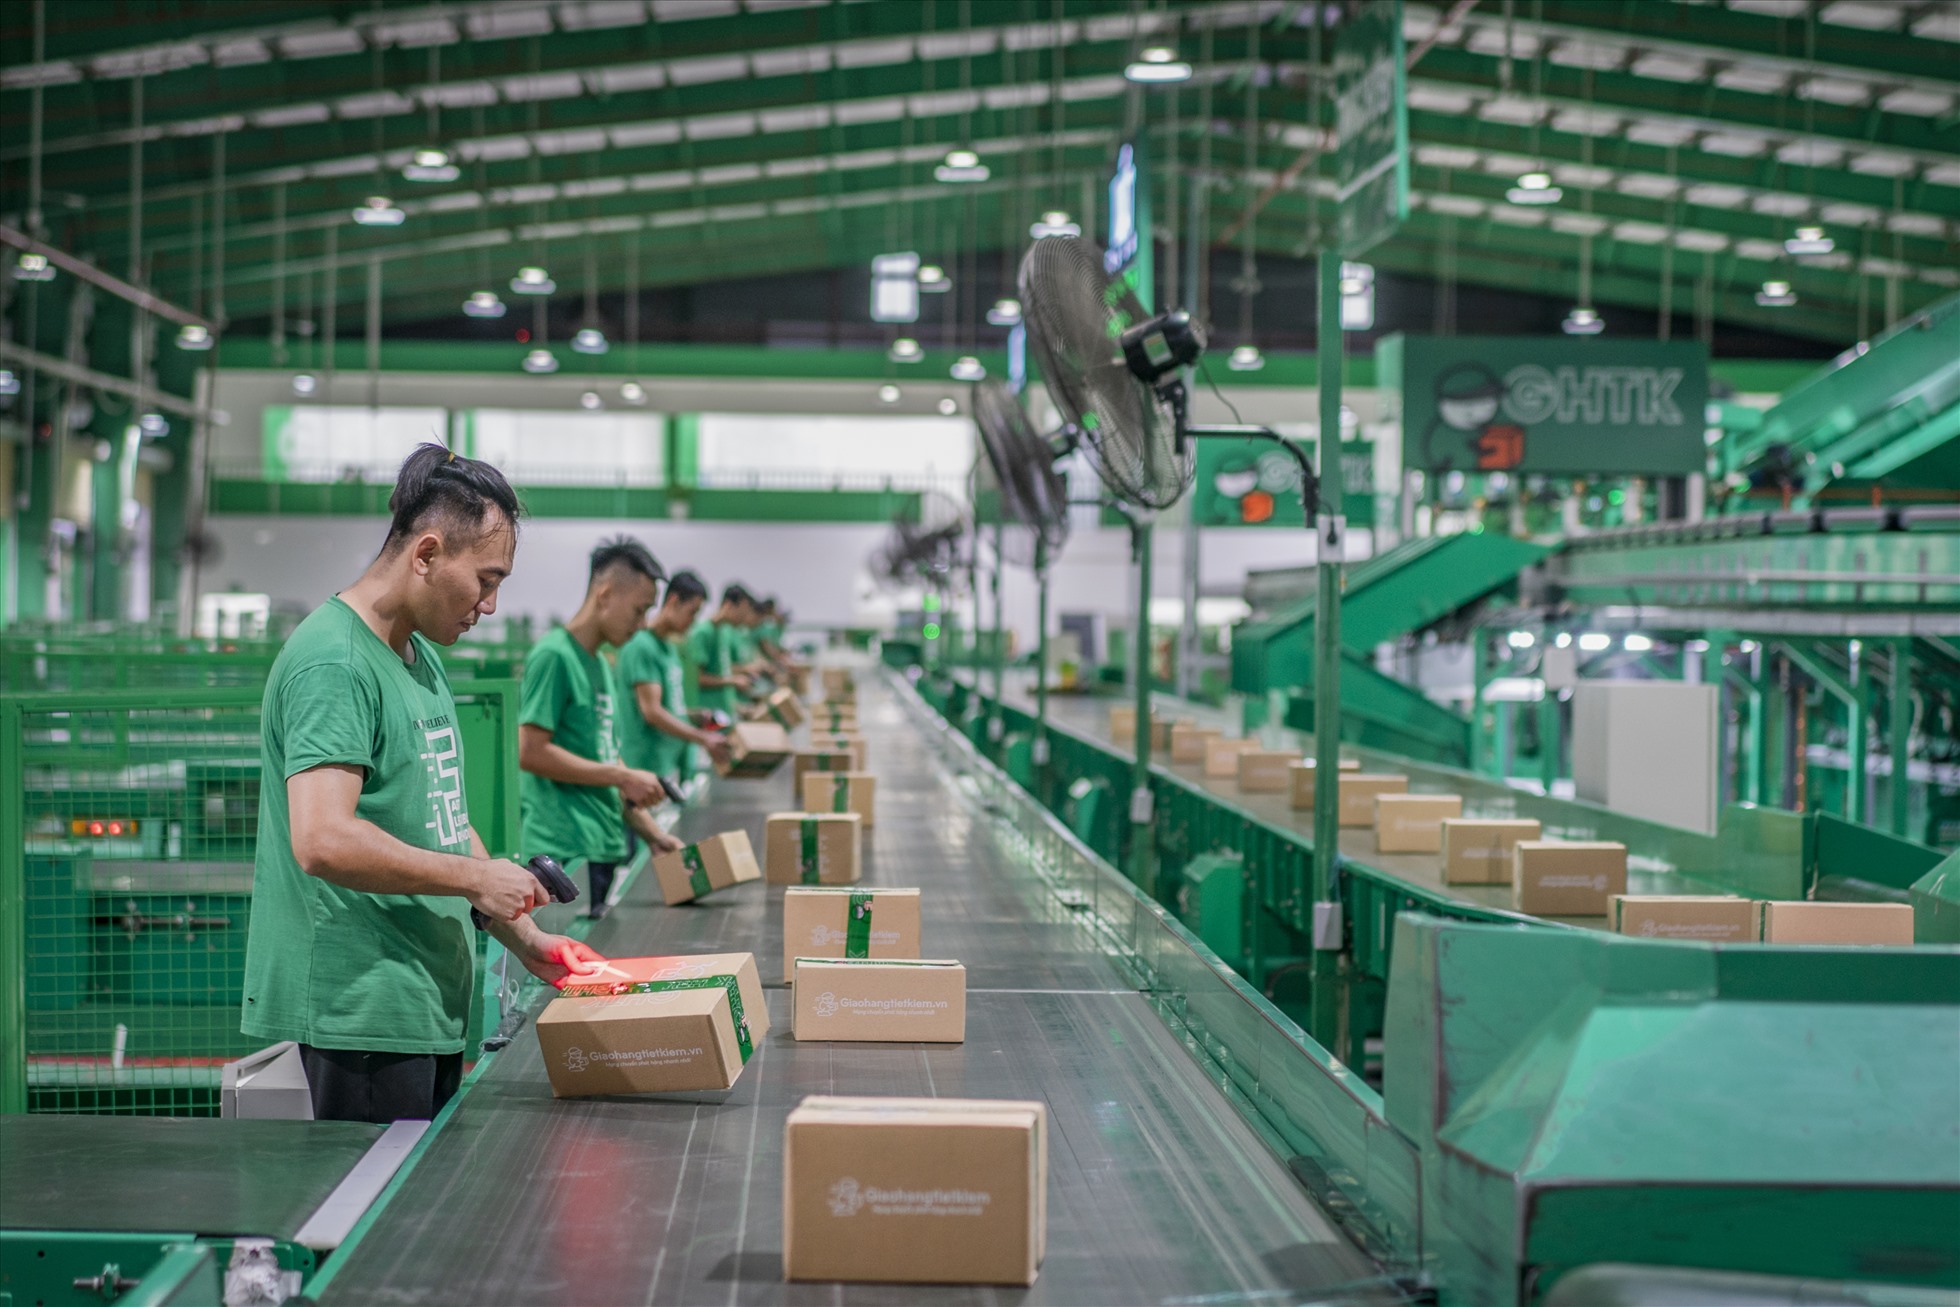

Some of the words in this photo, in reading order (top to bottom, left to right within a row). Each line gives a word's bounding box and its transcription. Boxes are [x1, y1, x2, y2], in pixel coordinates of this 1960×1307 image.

[1500, 363, 1685, 426] GHTK
[840, 997, 948, 1009] Giaohangtietkiem.vn
[589, 1047, 703, 1061] Giaohangtietkiem.vn
